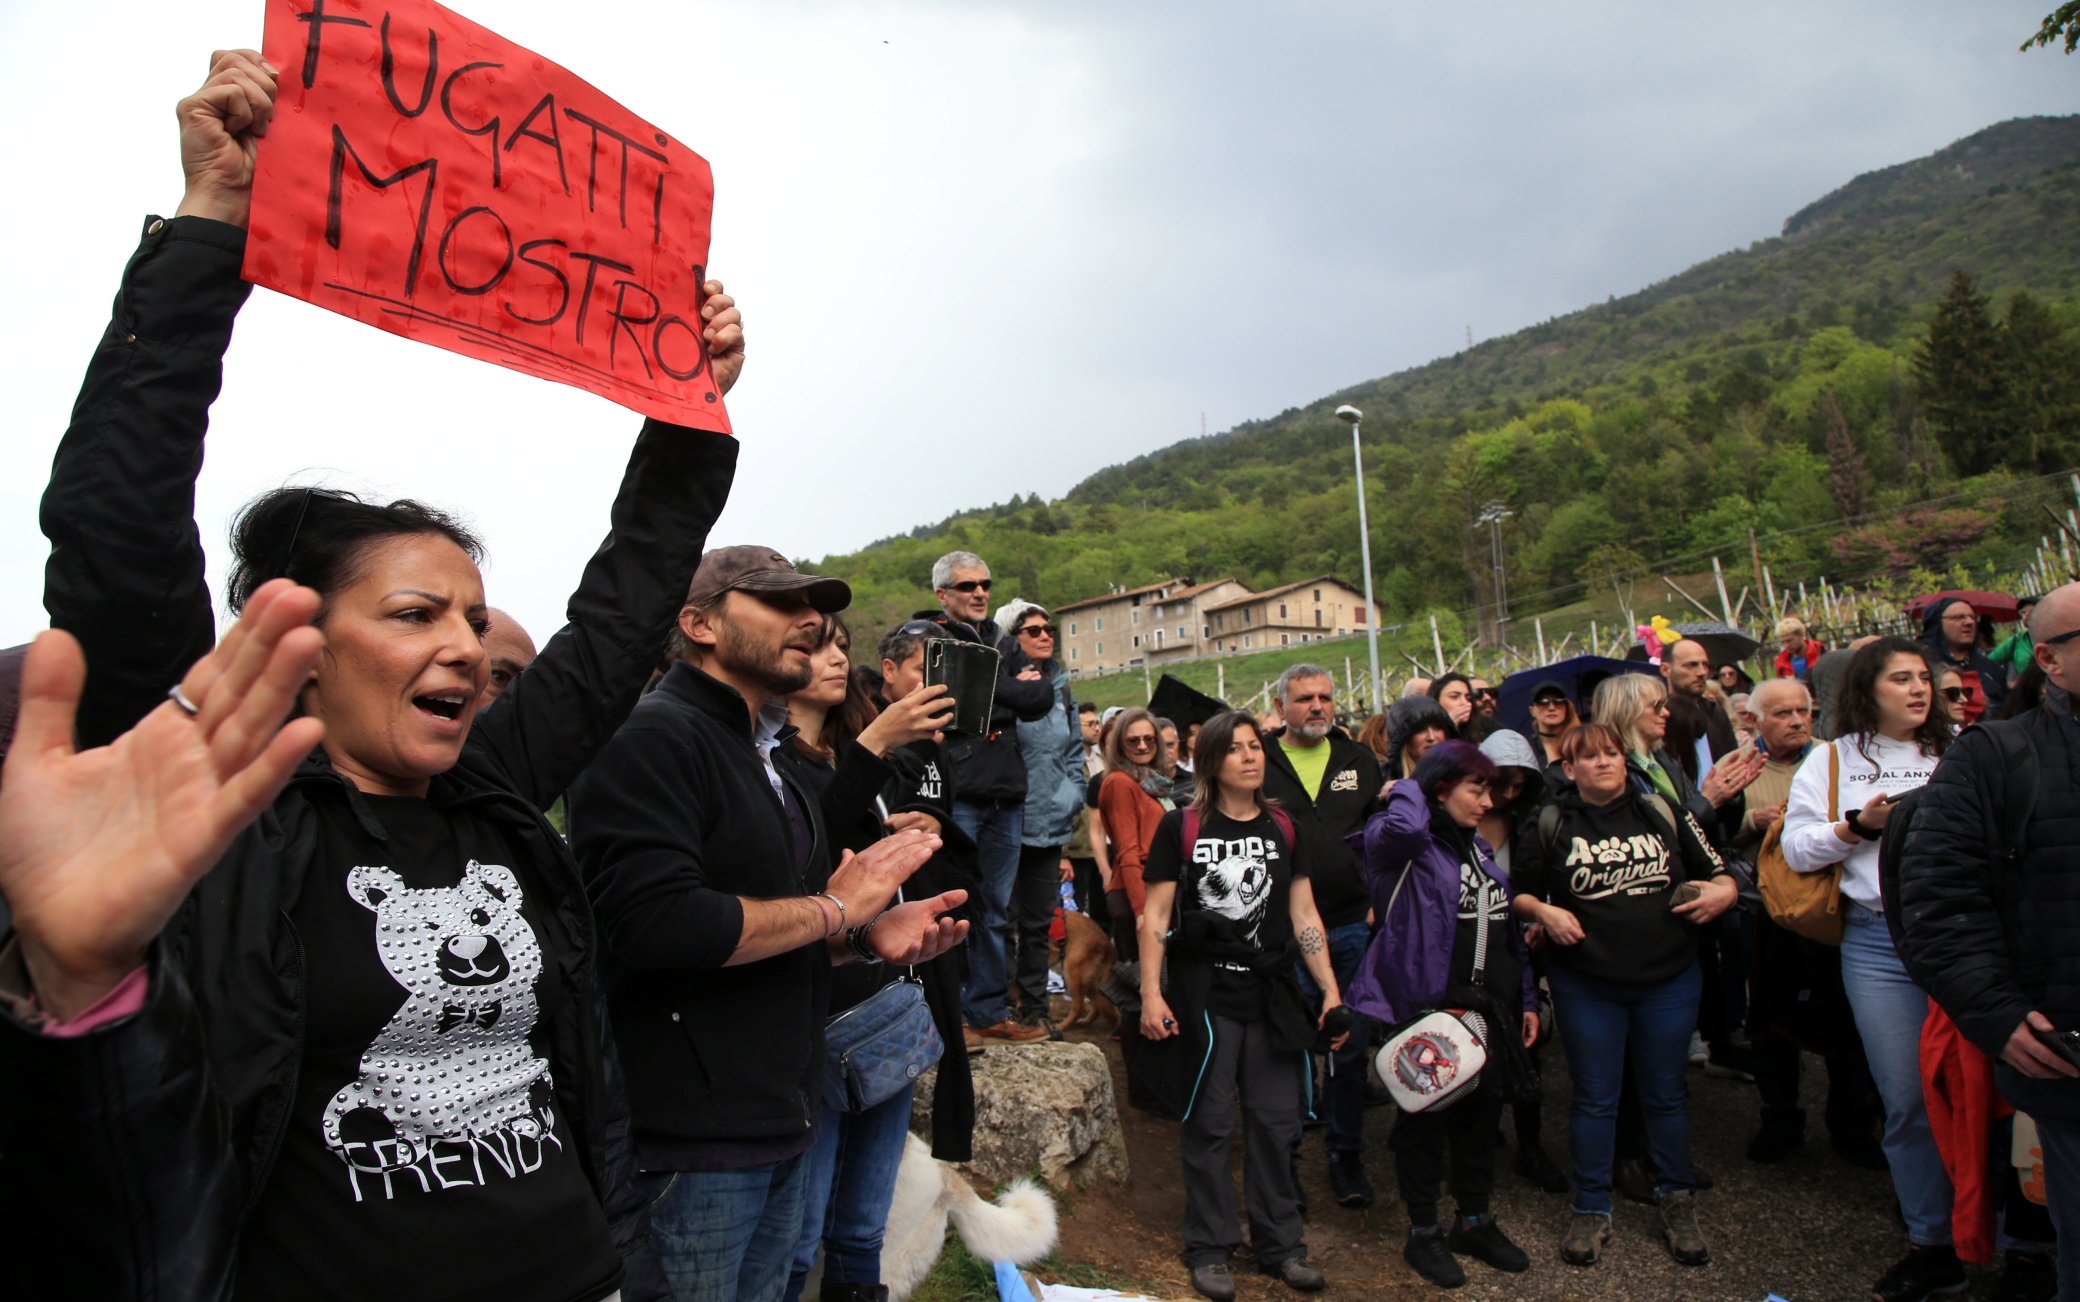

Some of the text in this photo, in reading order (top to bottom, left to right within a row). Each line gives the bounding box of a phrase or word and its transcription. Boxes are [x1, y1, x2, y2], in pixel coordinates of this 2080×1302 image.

[297, 0, 669, 244] FUGATTI
[1192, 836, 1264, 864] STOP
[1570, 849, 1671, 894] Original
